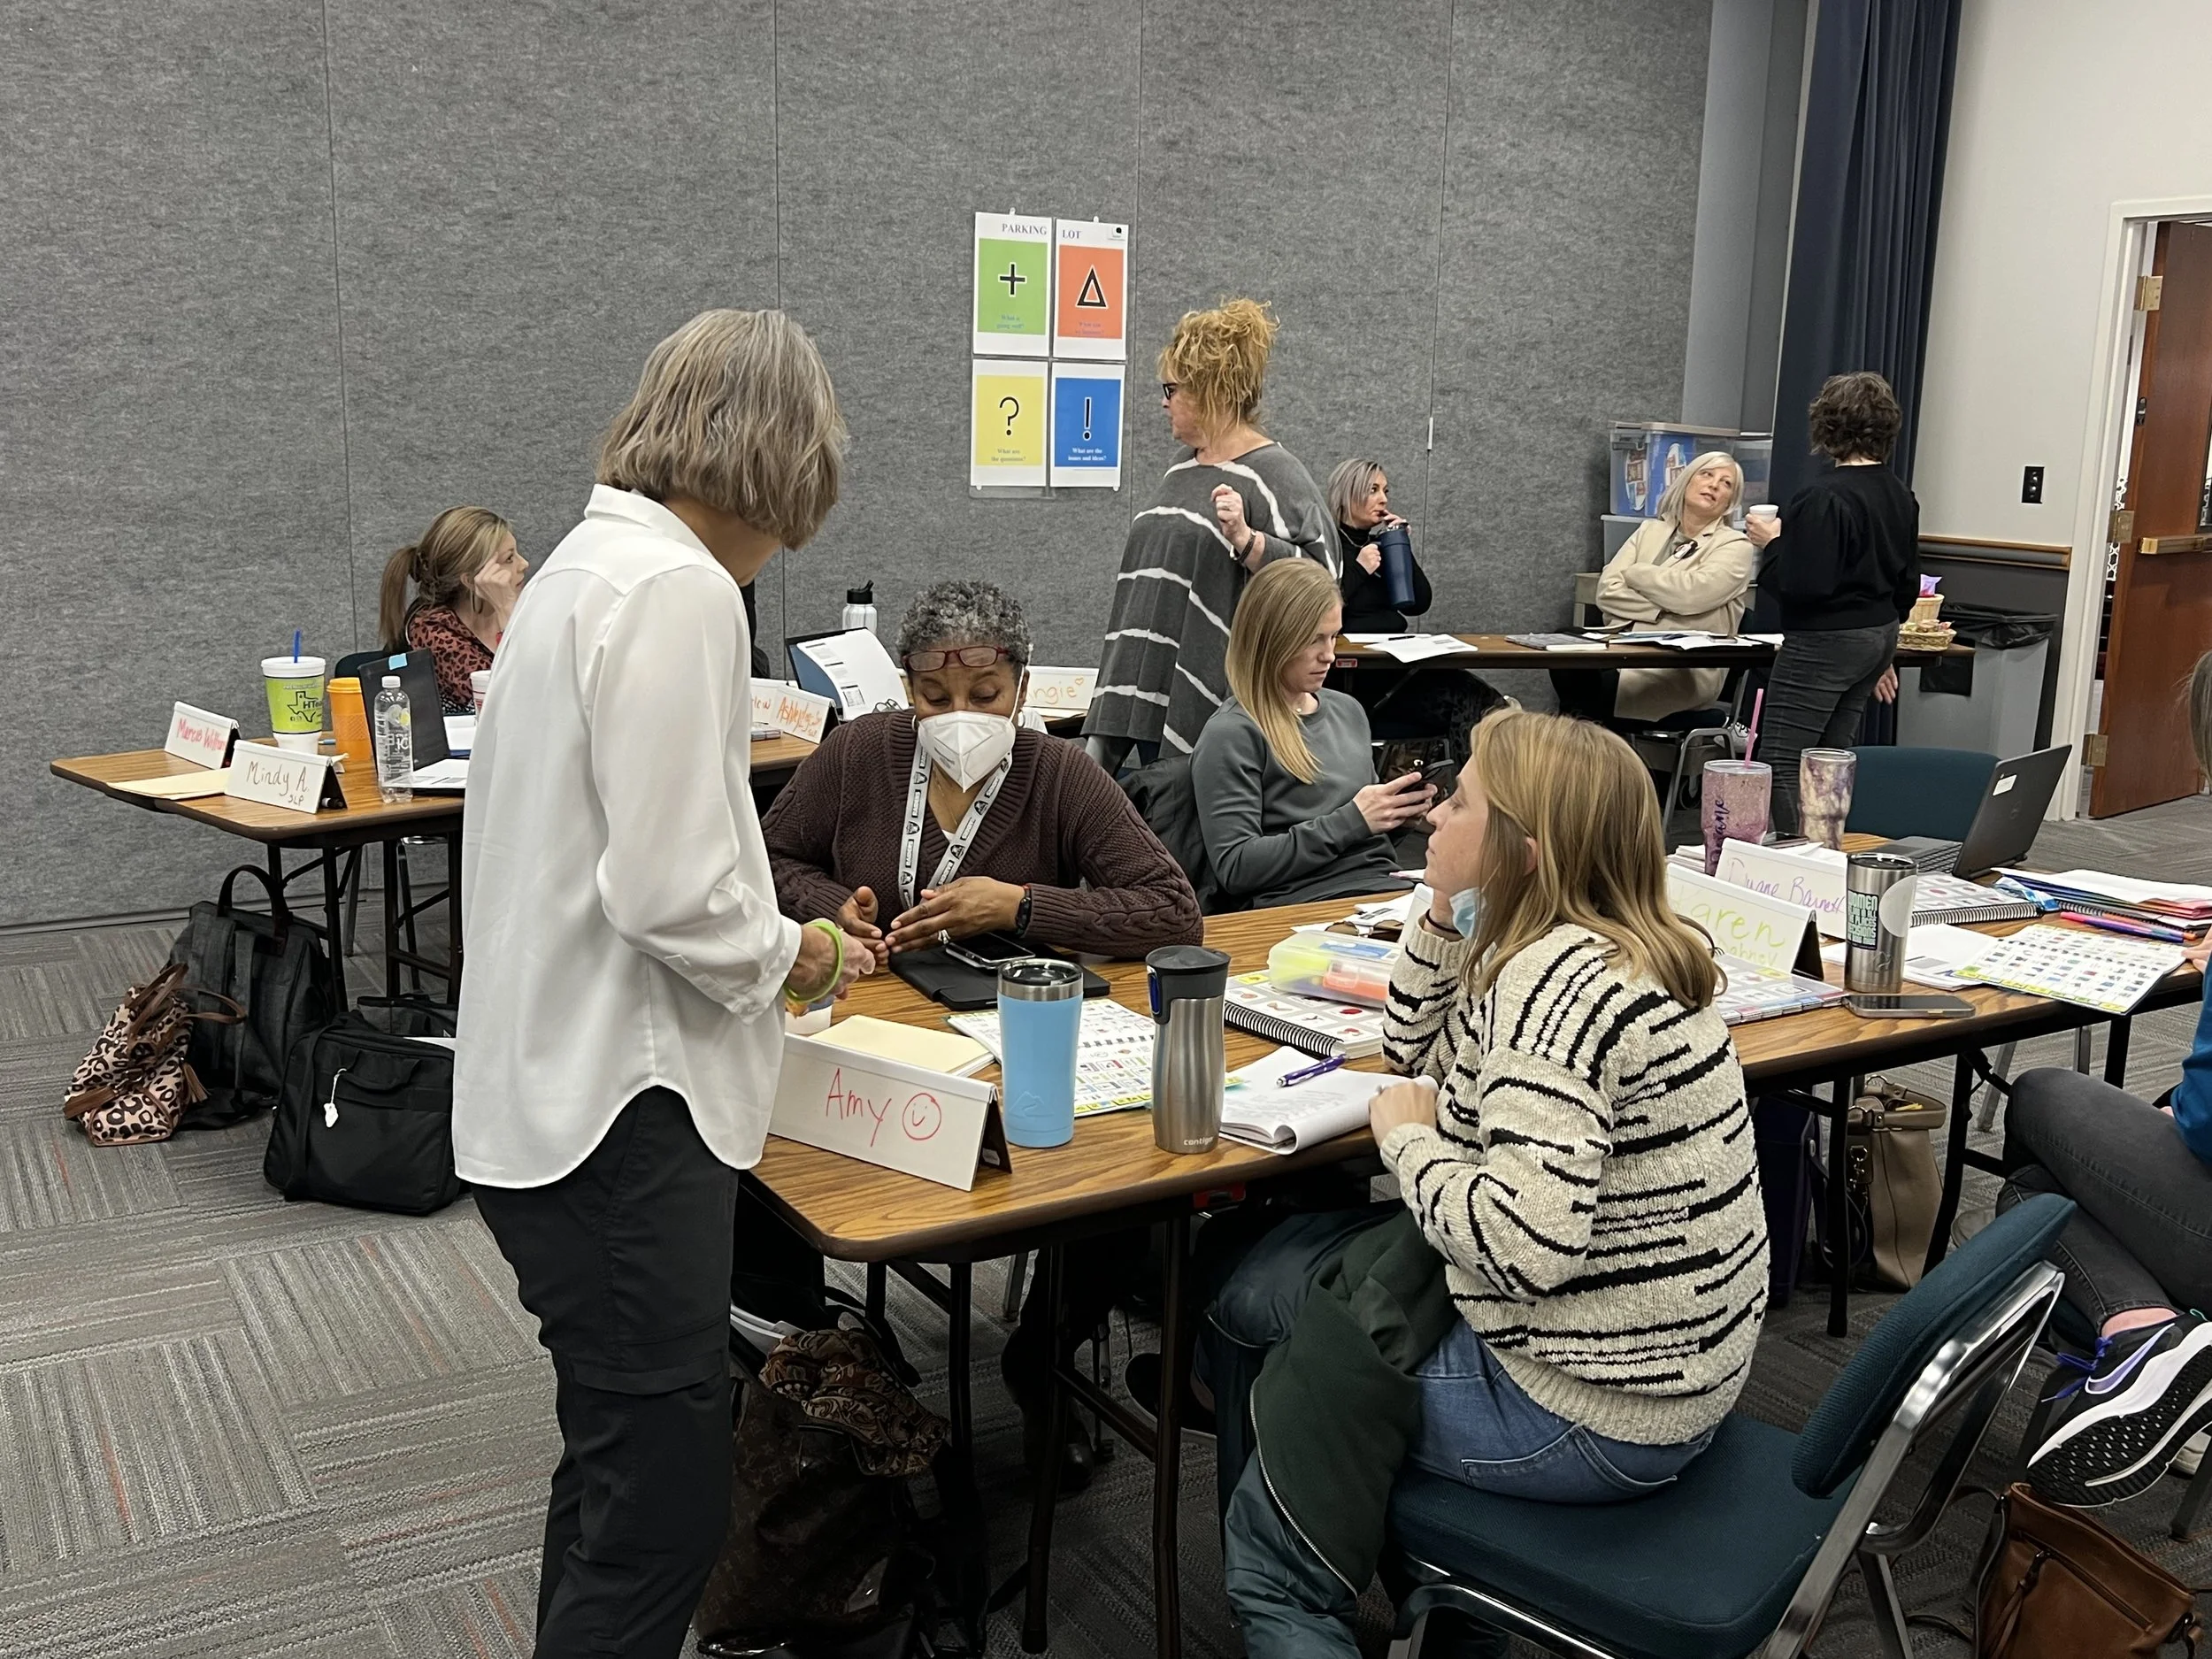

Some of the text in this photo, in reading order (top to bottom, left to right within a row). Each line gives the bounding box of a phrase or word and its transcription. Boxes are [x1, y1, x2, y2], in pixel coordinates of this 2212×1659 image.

[1002, 223, 1081, 239] PARKING LOT
[1028, 680, 1077, 705] ngie
[246, 761, 290, 796] Mindy
[1727, 857, 1780, 897] Duane
[826, 1067, 892, 1148] Amy
